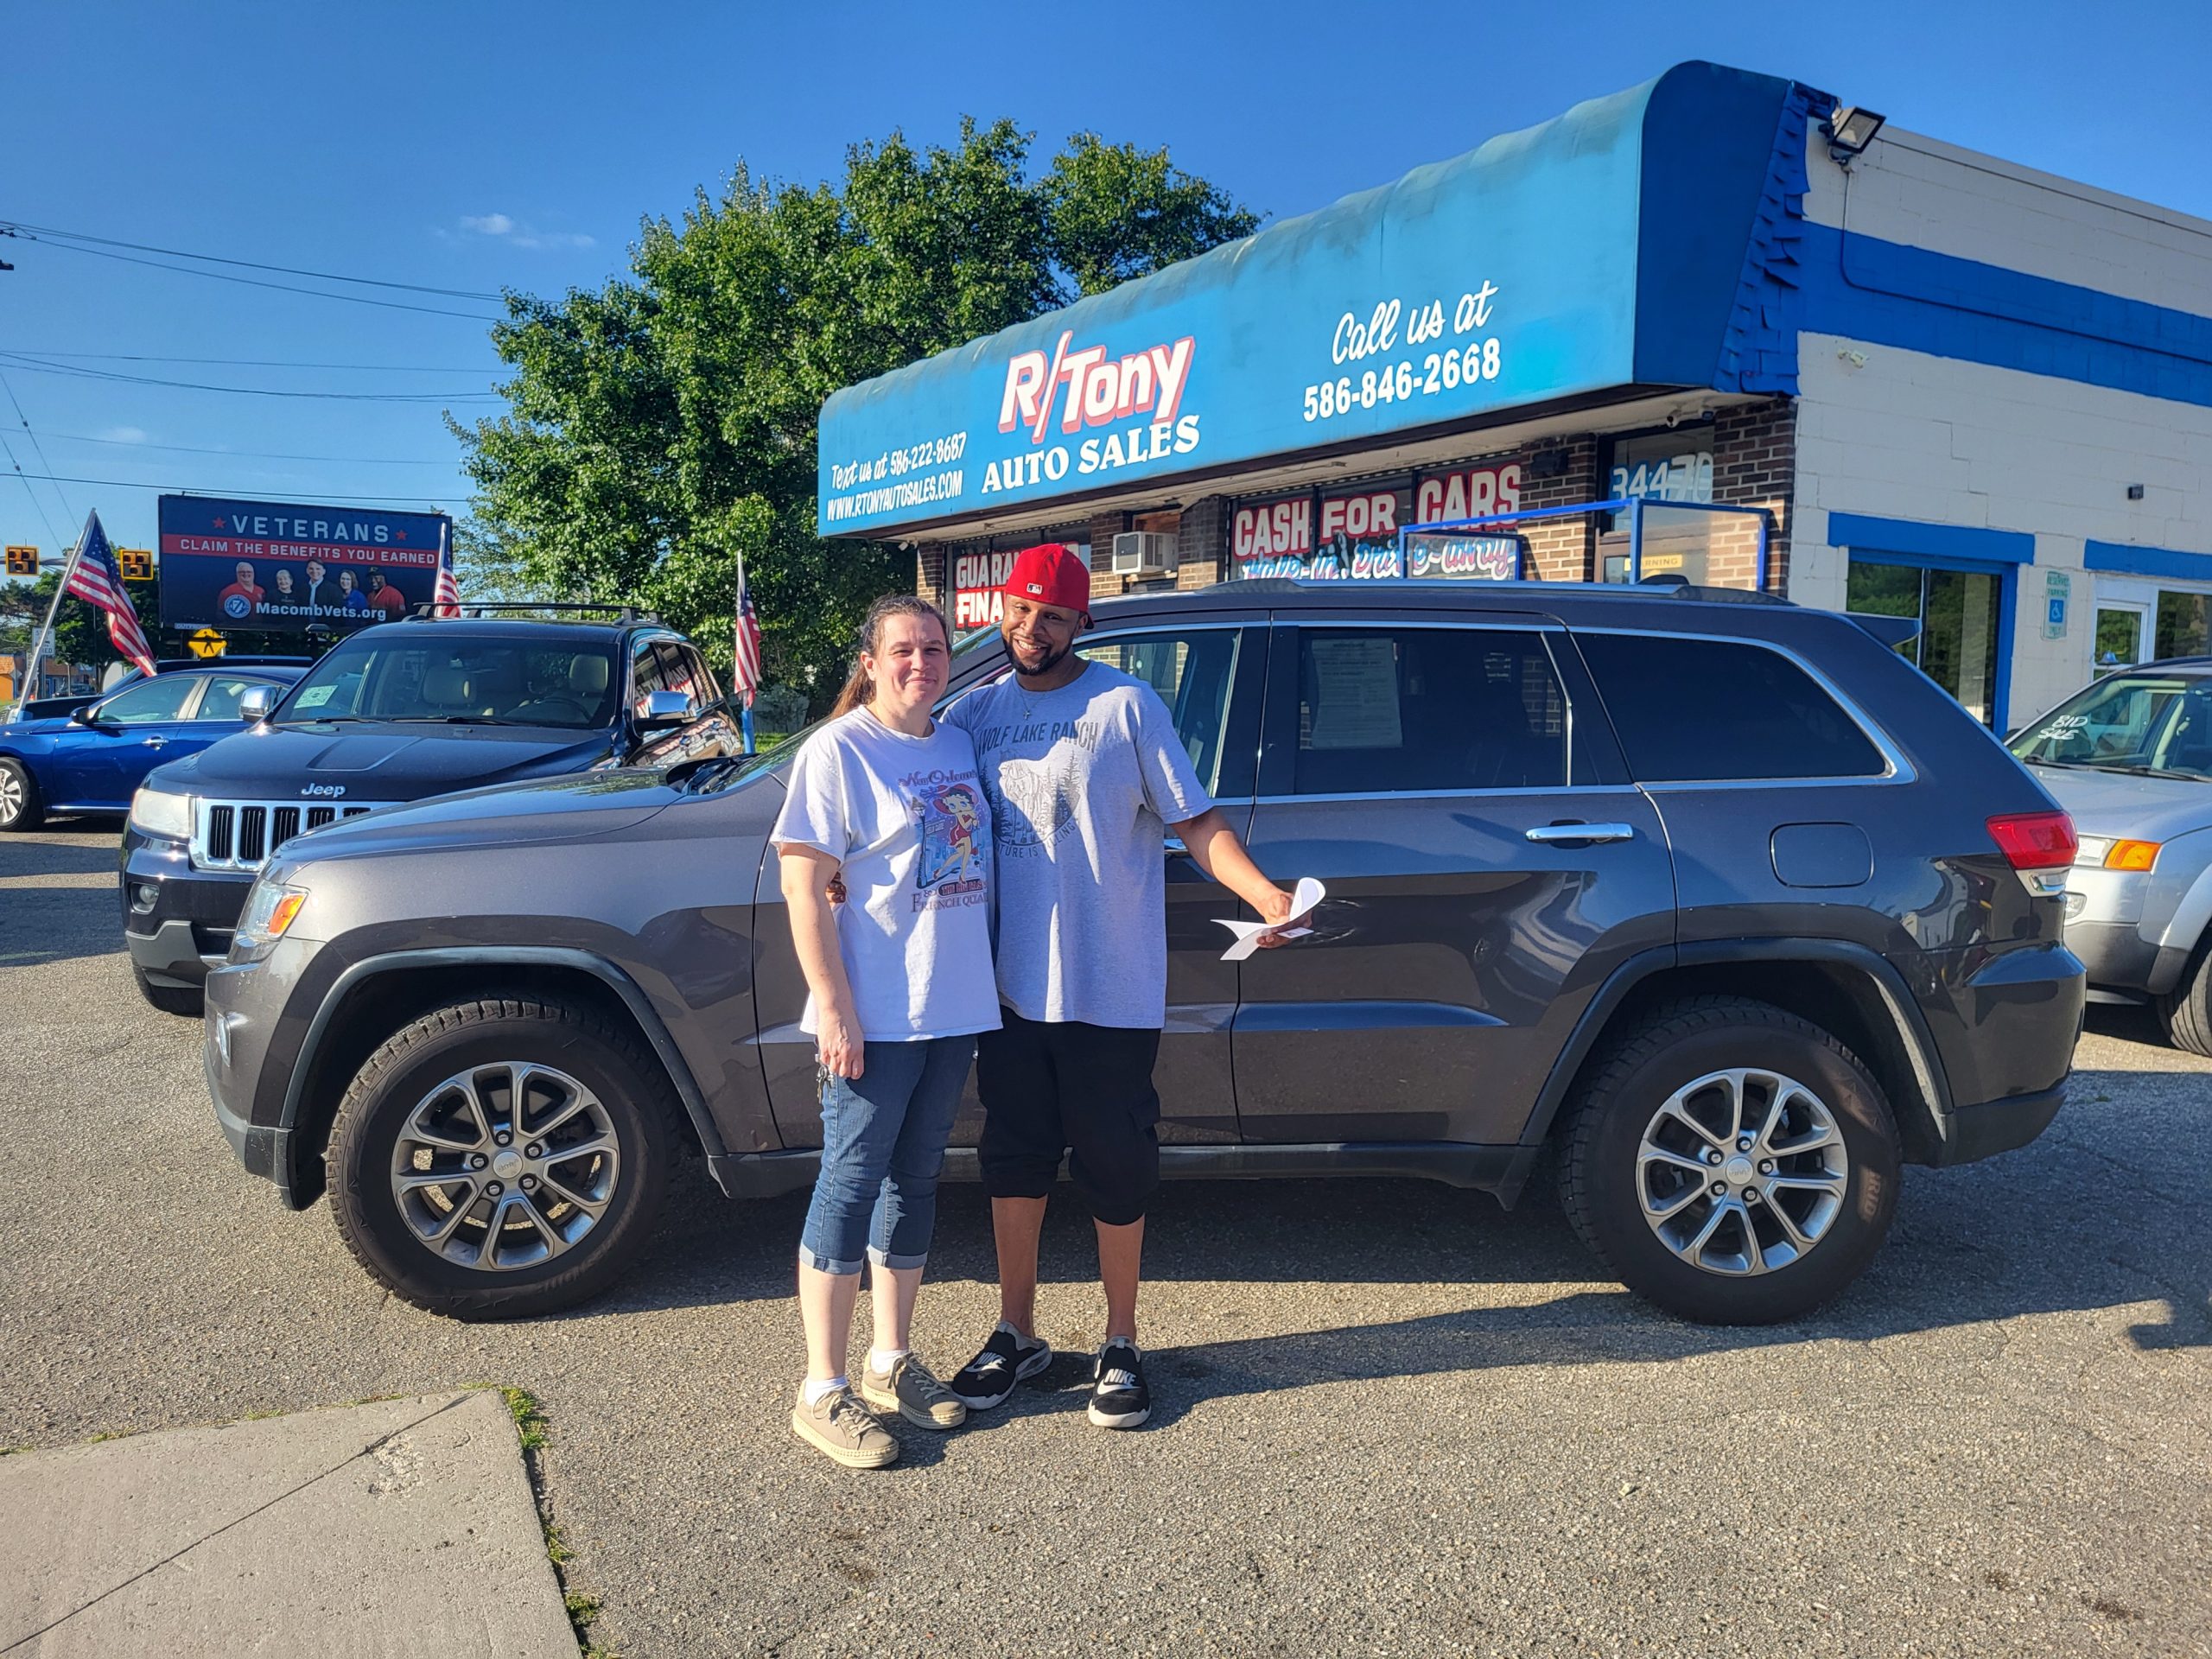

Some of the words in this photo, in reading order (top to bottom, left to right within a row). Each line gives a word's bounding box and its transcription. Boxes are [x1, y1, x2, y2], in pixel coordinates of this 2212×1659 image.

[1332, 298, 1402, 365] Call
[1407, 299, 1446, 345] us
[1453, 280, 1499, 334] at
[998, 330, 1196, 445] R/Tony
[1303, 337, 1501, 423] 586-846-2668
[831, 460, 858, 491] Text
[859, 460, 873, 483] us
[874, 452, 888, 480] at
[981, 446, 1070, 493] AUTO
[1077, 415, 1200, 474] SALES
[827, 469, 963, 522] WWW.RTONYAUTOSALES.COM
[1611, 451, 1713, 504] 34470
[232, 514, 389, 543] VETERANS
[1233, 499, 1313, 560] CASH
[1319, 492, 1398, 544] FOR
[1415, 464, 1522, 530] CARS
[180, 539, 228, 552] CLAIM
[235, 543, 264, 554] THE
[270, 544, 340, 558] BENEFITS
[347, 550, 375, 560] YOU
[381, 551, 435, 564] EARNED
[956, 550, 1020, 589] GUARA
[1644, 557, 1679, 567] RNING
[256, 602, 386, 621] MacombVets.org
[1012, 722, 1047, 743] LAKE
[1050, 721, 1099, 754] RANCH
[302, 783, 346, 798] Jeep
[1028, 846, 1039, 858] IS
[1104, 1368, 1136, 1384] NIKE
